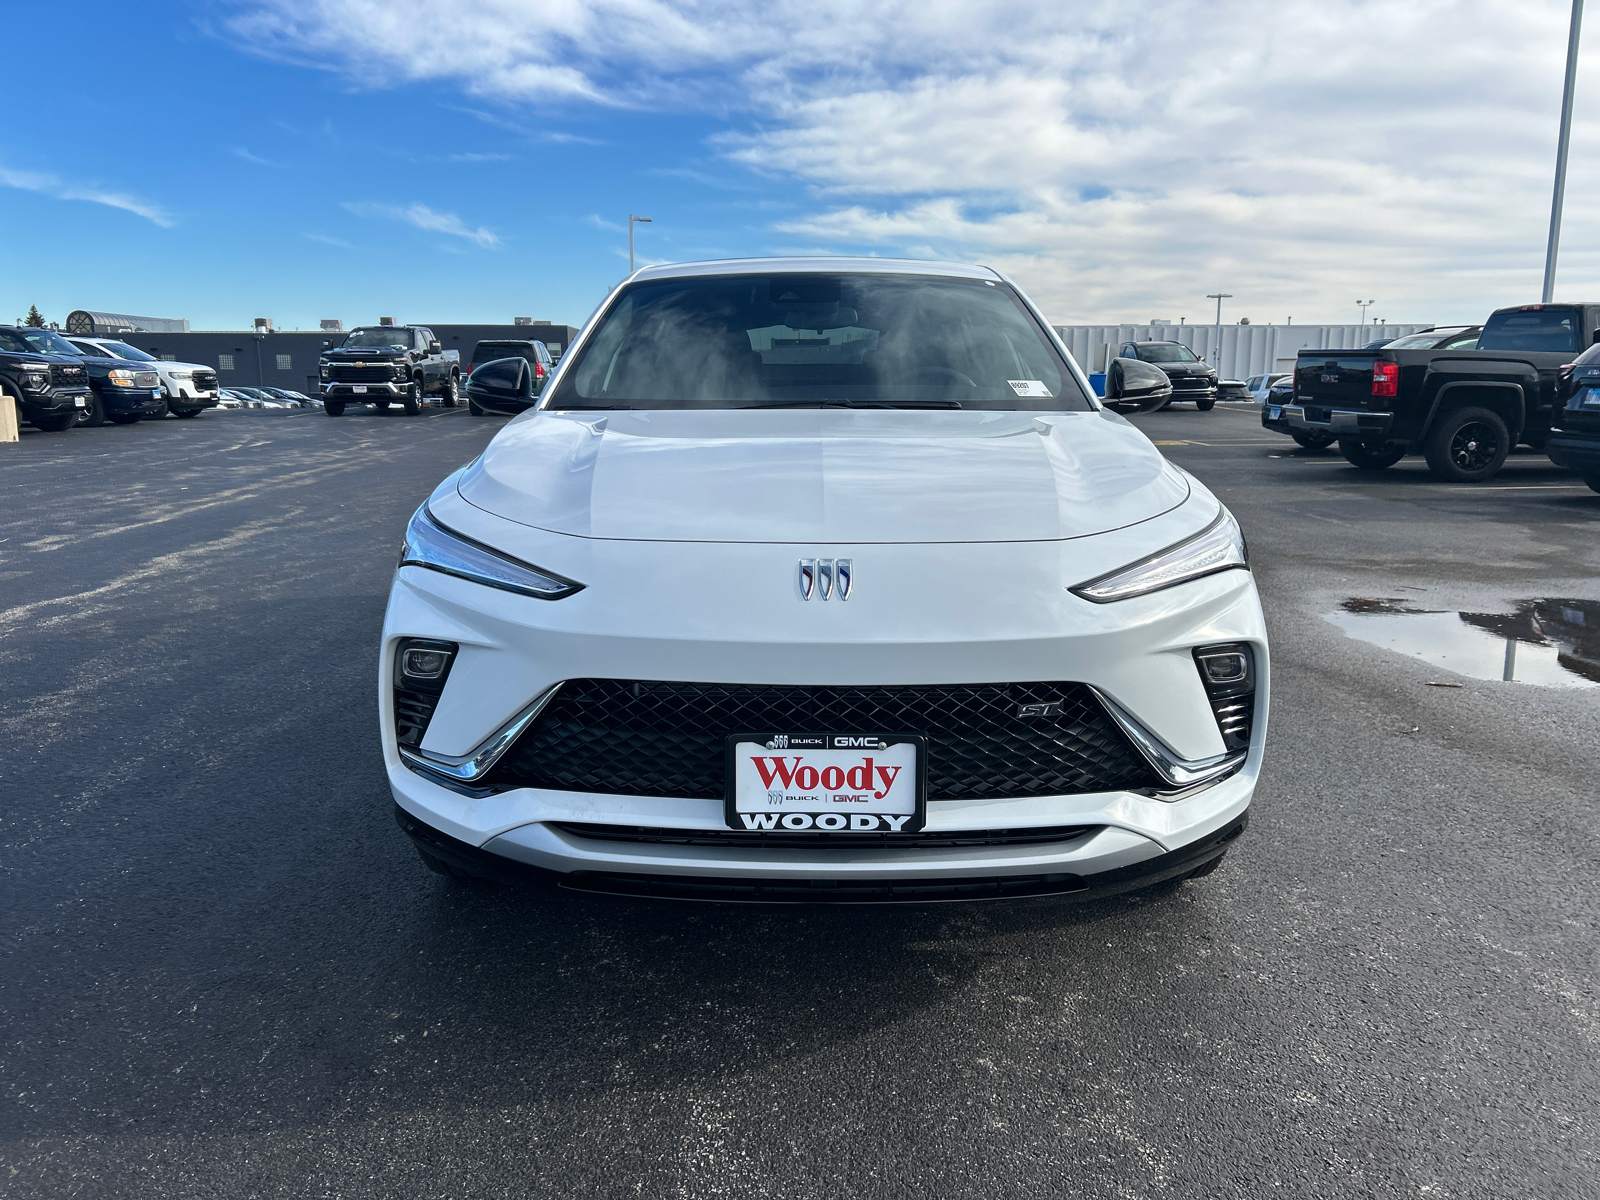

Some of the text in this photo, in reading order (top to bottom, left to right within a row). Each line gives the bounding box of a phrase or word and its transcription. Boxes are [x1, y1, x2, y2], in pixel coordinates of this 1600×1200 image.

[834, 736, 879, 747] GMC
[750, 756, 902, 800] Woody
[832, 794, 869, 803] GMC
[739, 813, 912, 831] WOODY
